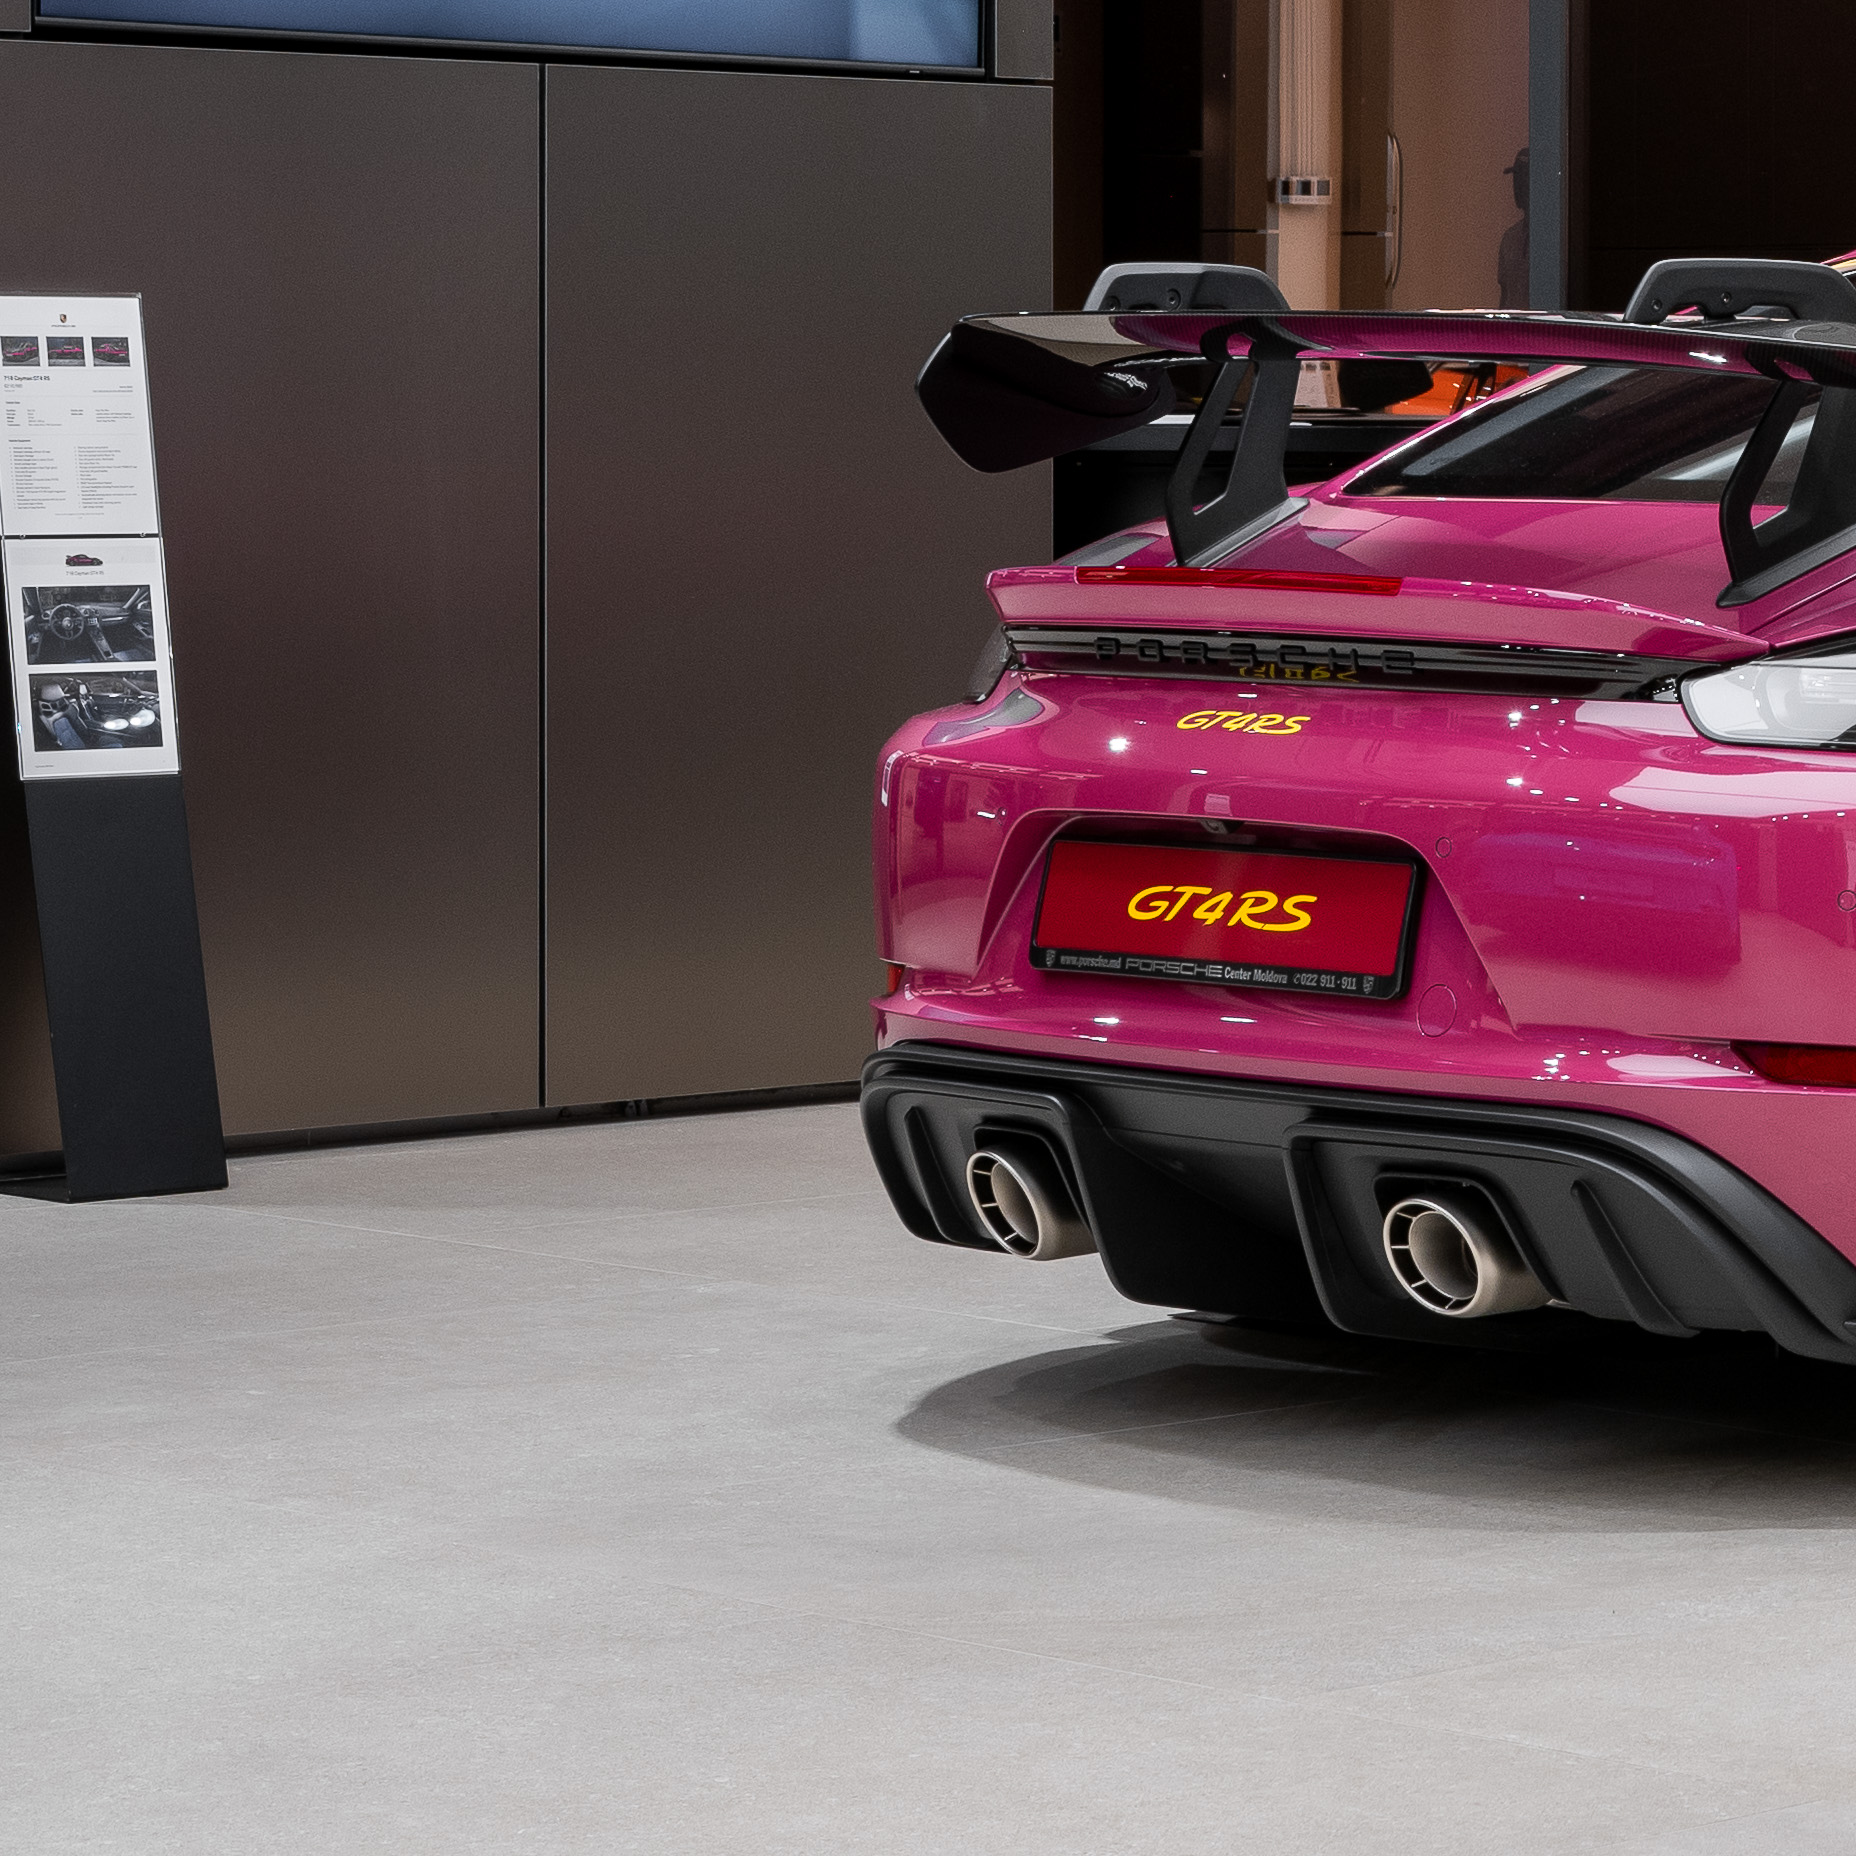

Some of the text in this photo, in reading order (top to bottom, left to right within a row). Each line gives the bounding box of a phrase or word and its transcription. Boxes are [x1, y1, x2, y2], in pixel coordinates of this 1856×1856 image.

[1094, 636, 1415, 675] PORSCHE
[1176, 710, 1311, 735] GT4RS
[1127, 885, 1318, 932] GT4RS
[1126, 957, 1223, 978] PORSCHE
[1225, 966, 1251, 980] Center
[1253, 969, 1288, 984] Moldova
[1301, 974, 1318, 986] 022
